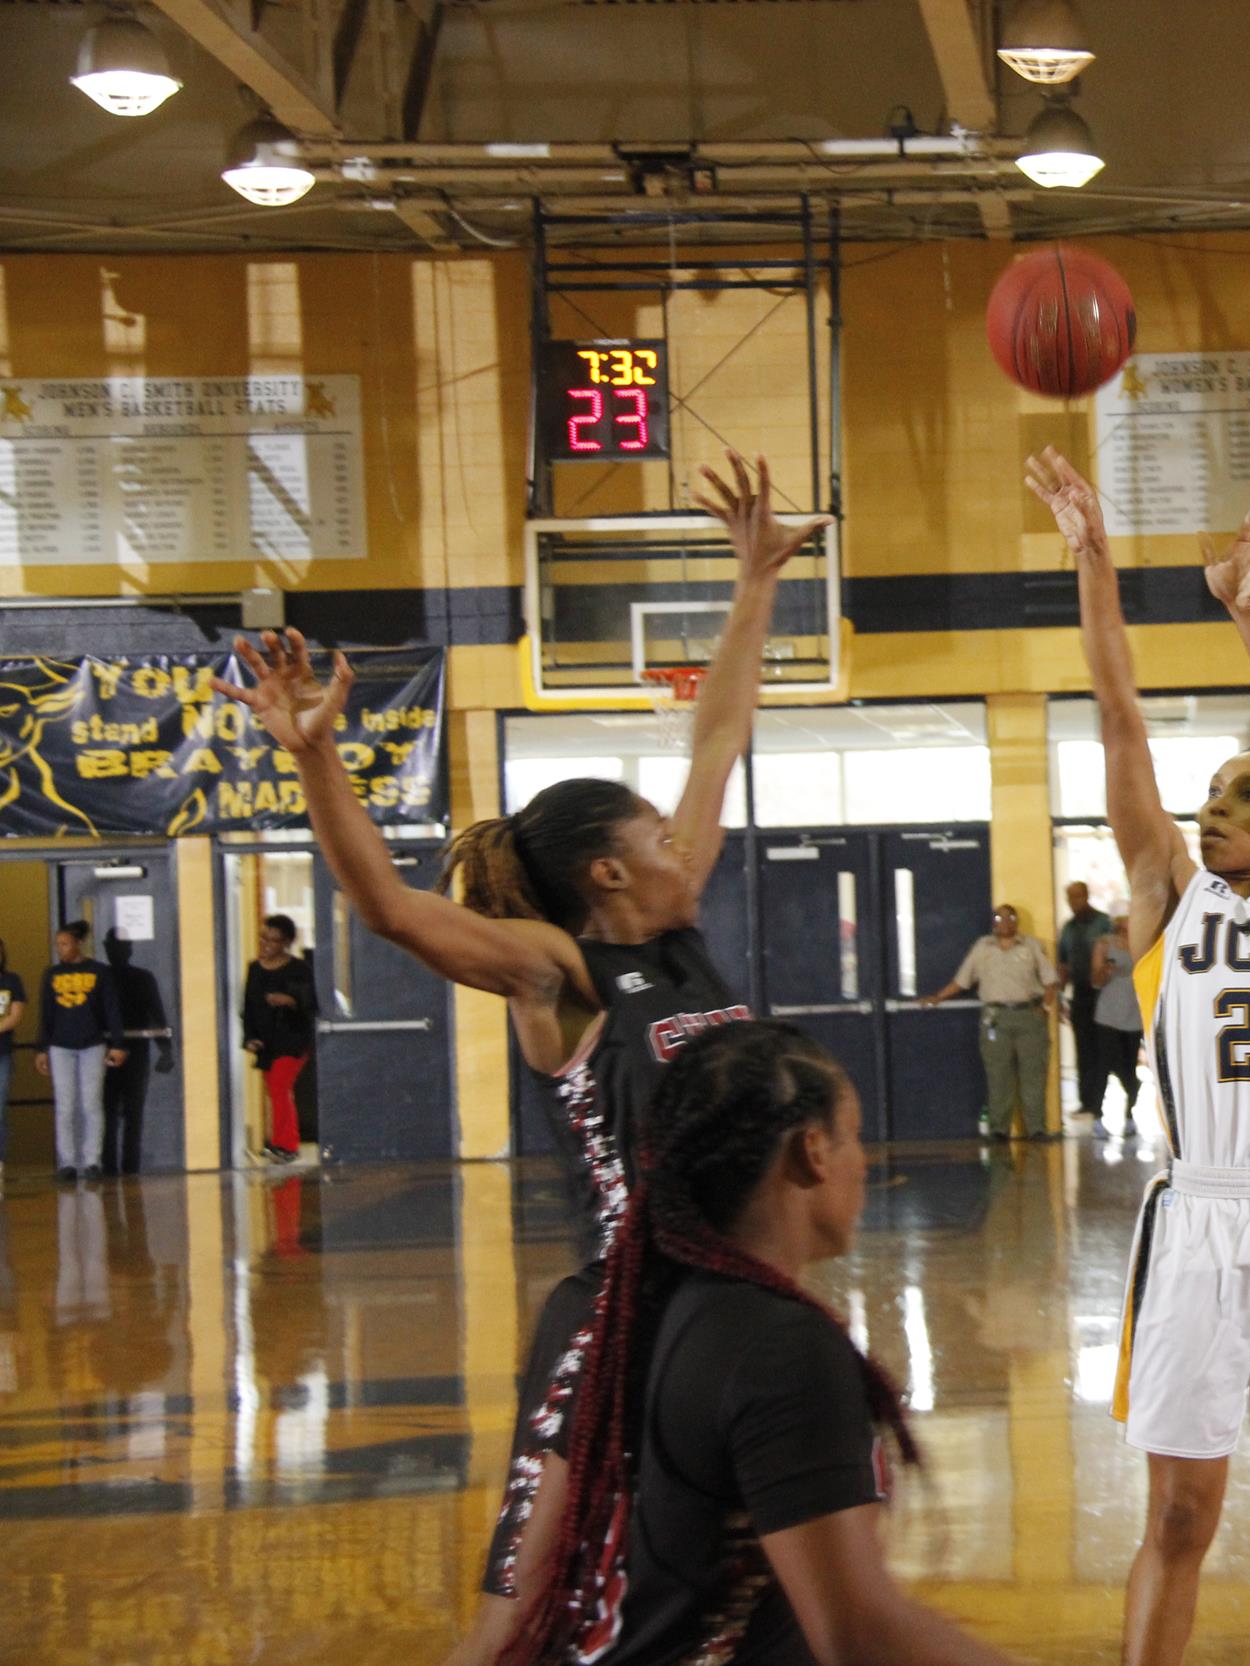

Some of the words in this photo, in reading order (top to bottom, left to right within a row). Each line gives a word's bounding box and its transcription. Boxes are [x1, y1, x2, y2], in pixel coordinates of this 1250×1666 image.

[577, 350, 657, 385] 7:32
[121, 400, 226, 417] BASKETBALL
[234, 399, 287, 415] STATS
[144, 382, 194, 398] SMITH
[202, 381, 299, 397] UNIVERSITY
[567, 388, 648, 451] 23
[91, 662, 215, 704] YOU
[71, 713, 160, 746] stand
[181, 703, 245, 742] NO
[360, 706, 437, 733] inside
[217, 774, 433, 820] MADESS
